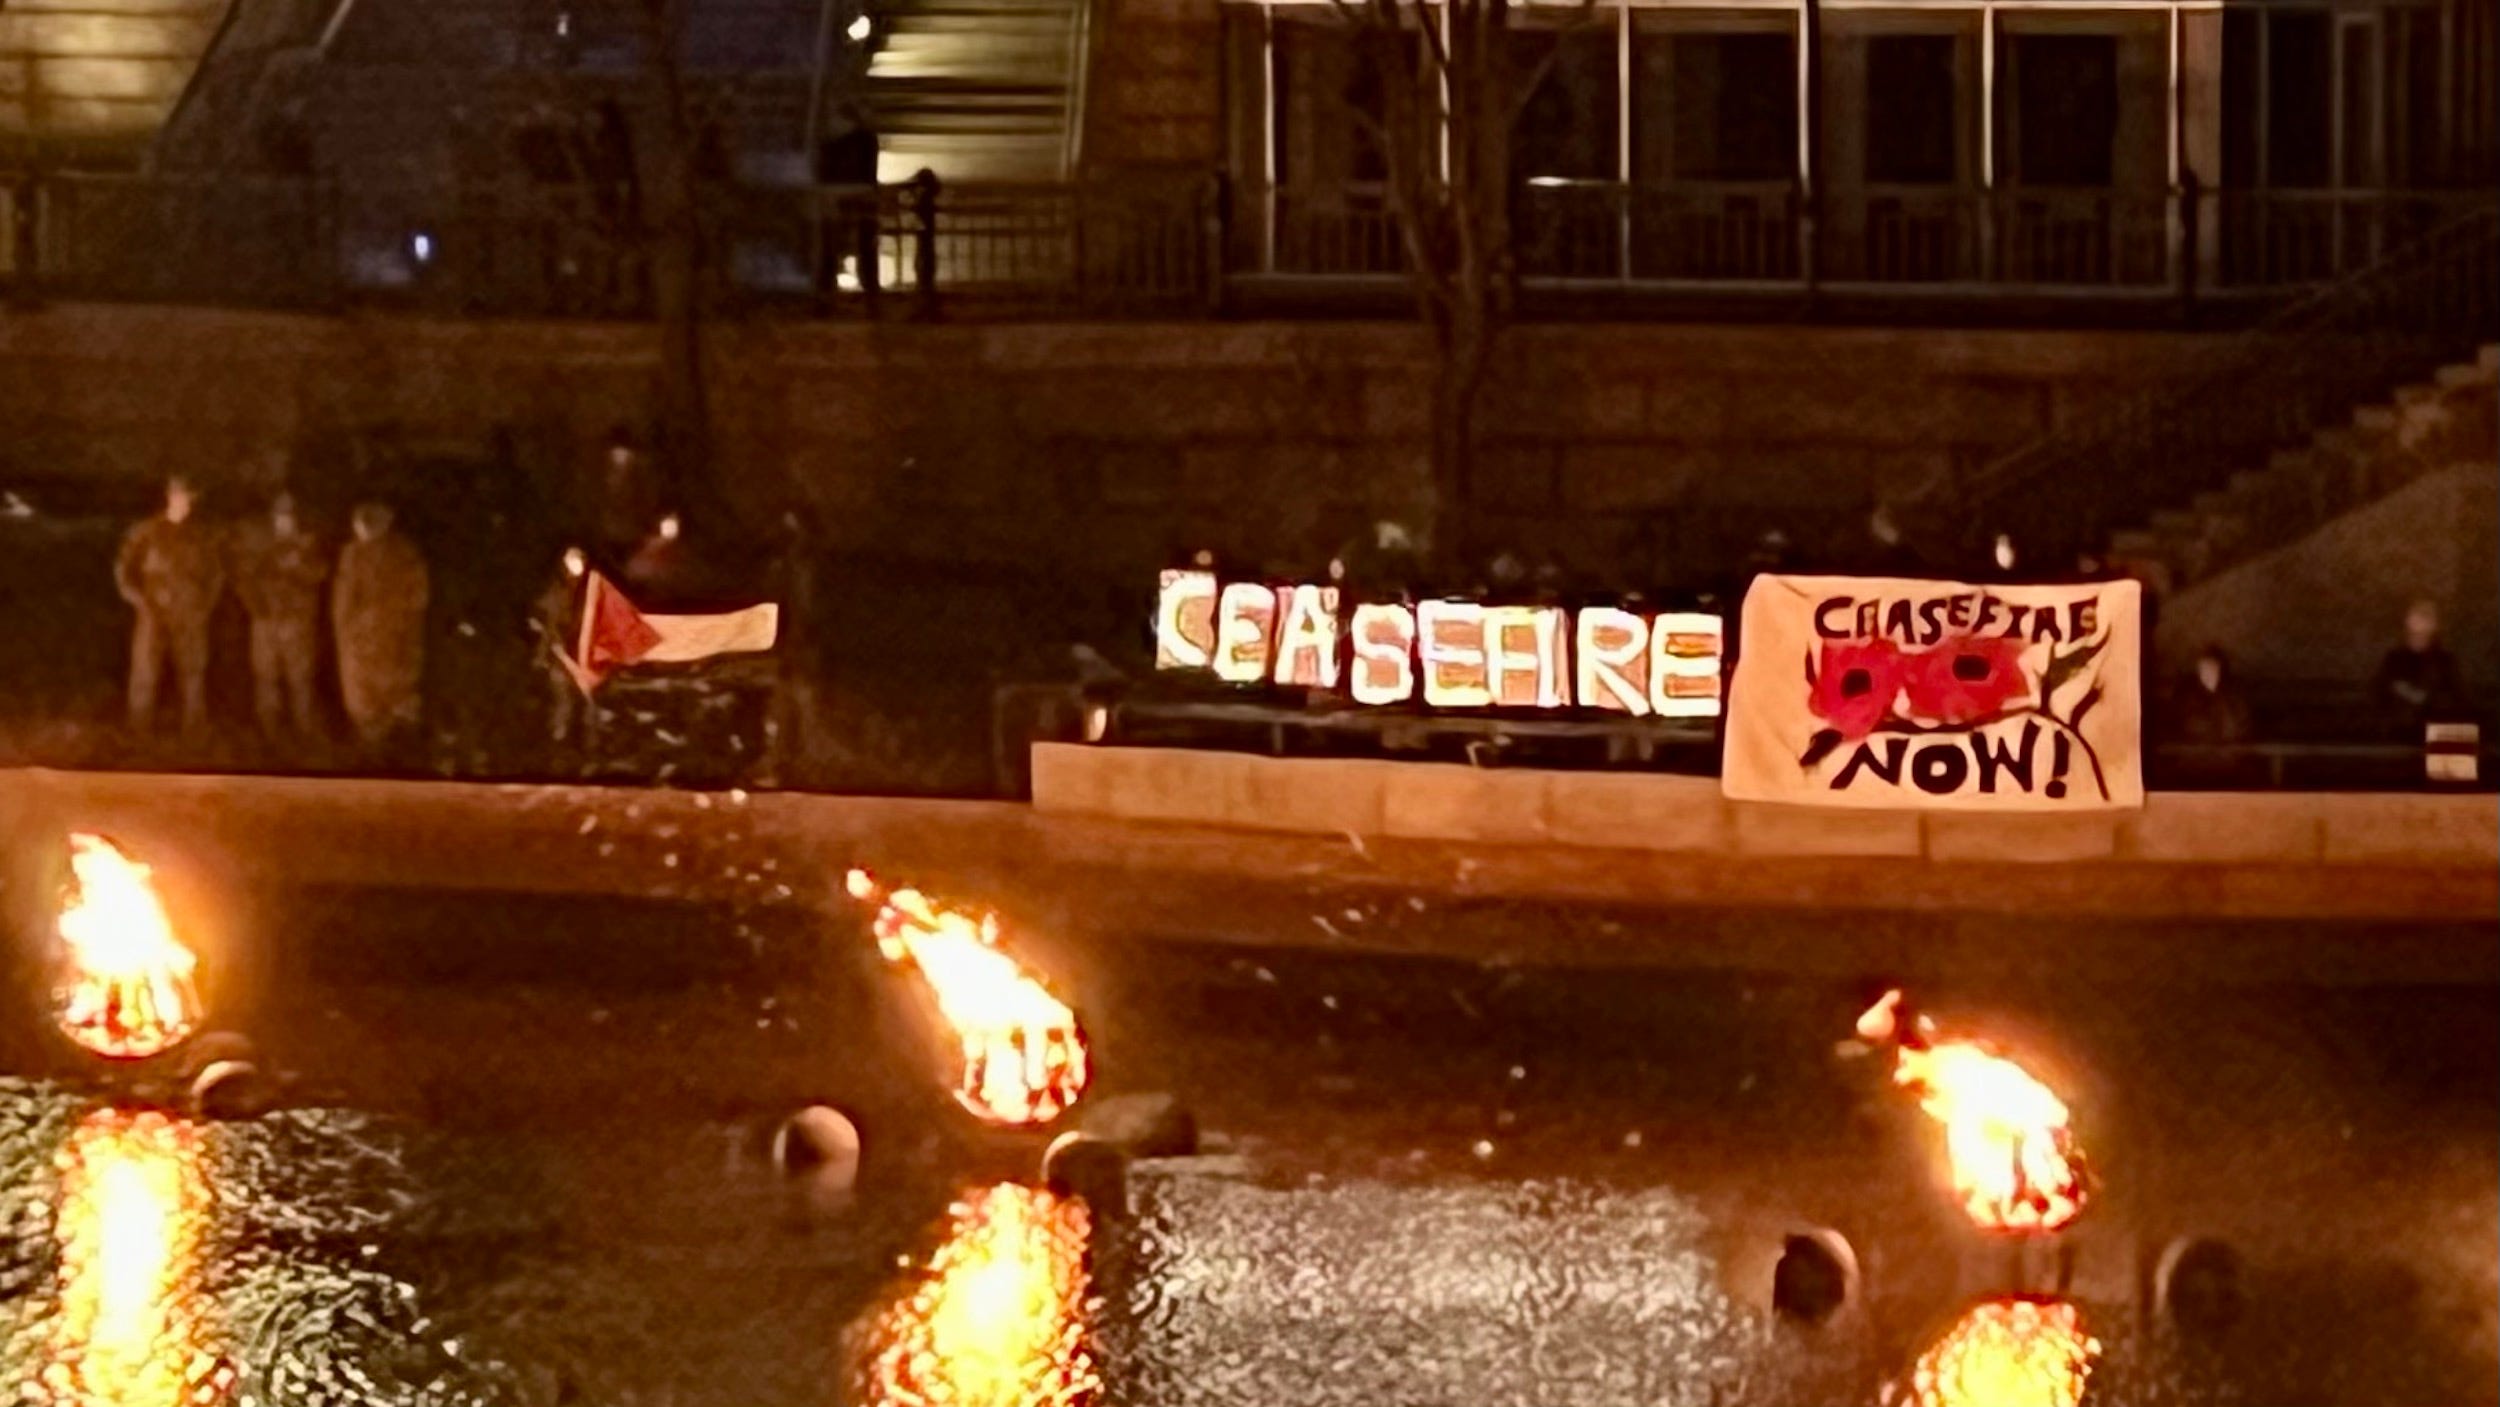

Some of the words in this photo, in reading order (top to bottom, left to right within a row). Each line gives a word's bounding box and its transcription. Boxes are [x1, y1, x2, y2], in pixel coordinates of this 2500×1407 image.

[1158, 571, 1723, 717] CEASEFIRE
[1814, 593, 2099, 645] CEASEFIRE
[1829, 718, 2070, 799] NOW!
